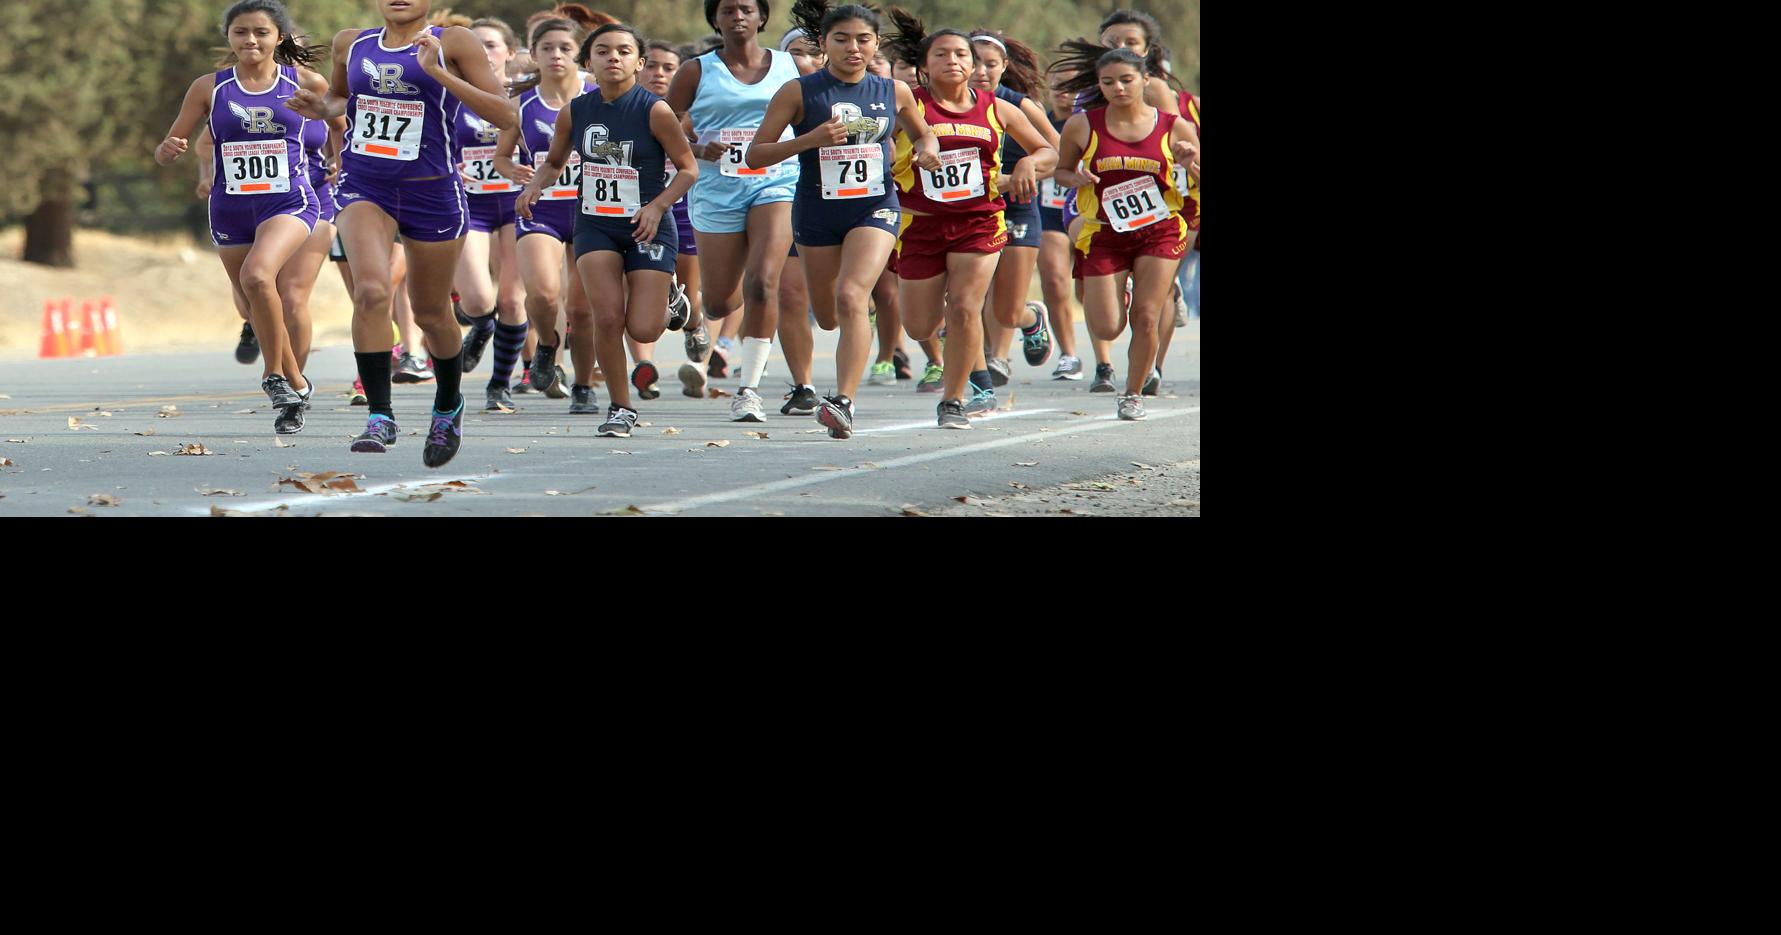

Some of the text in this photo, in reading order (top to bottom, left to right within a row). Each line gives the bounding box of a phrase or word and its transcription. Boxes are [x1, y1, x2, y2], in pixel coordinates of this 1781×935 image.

[397, 102, 423, 111] CONFERENCE
[362, 112, 412, 142] 317
[233, 156, 278, 180] 300
[838, 160, 868, 184] 79
[930, 162, 972, 188] 687
[596, 178, 622, 202] 81
[1112, 190, 1156, 220] 691
